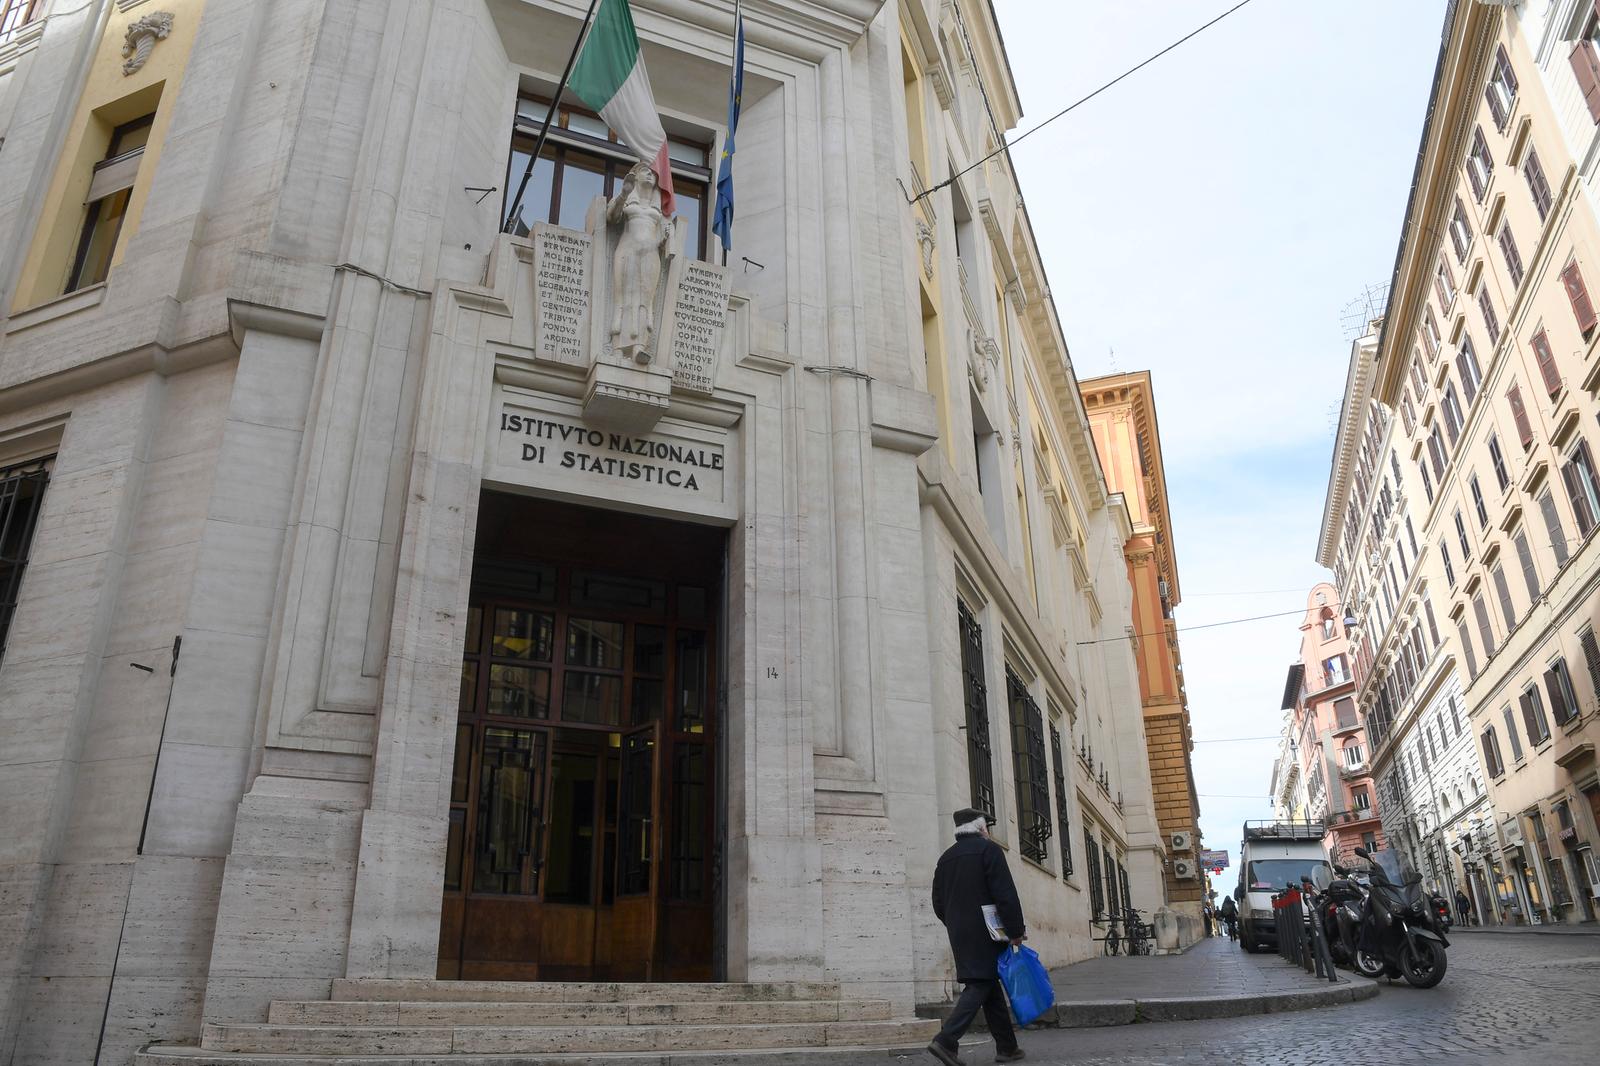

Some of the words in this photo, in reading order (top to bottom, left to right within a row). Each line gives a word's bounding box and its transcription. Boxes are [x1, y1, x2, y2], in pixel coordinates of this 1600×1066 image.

[543, 241, 584, 256] STRVCTIS
[544, 251, 583, 266] MOLIBVS
[542, 261, 584, 276] LITTERAE
[557, 294, 587, 307] INDICTA
[699, 297, 721, 309] DONA
[542, 301, 582, 316] GENTIBVS
[543, 311, 578, 326] TRIBVTA
[543, 321, 576, 335] PONDVS
[543, 333, 581, 347] ARGENTI
[678, 331, 708, 344] COPIAS
[543, 343, 555, 351] ET
[560, 347, 580, 357] AVRI
[674, 340, 715, 356] FRVMENTI
[674, 350, 713, 365] QVAEQVE
[678, 361, 703, 372] NATIO
[500, 413, 604, 447] ISTITVTO
[608, 433, 724, 471] NAZIONALE
[521, 443, 545, 464] DI
[560, 450, 699, 491] STATISTICA
[767, 666, 779, 680] 14
